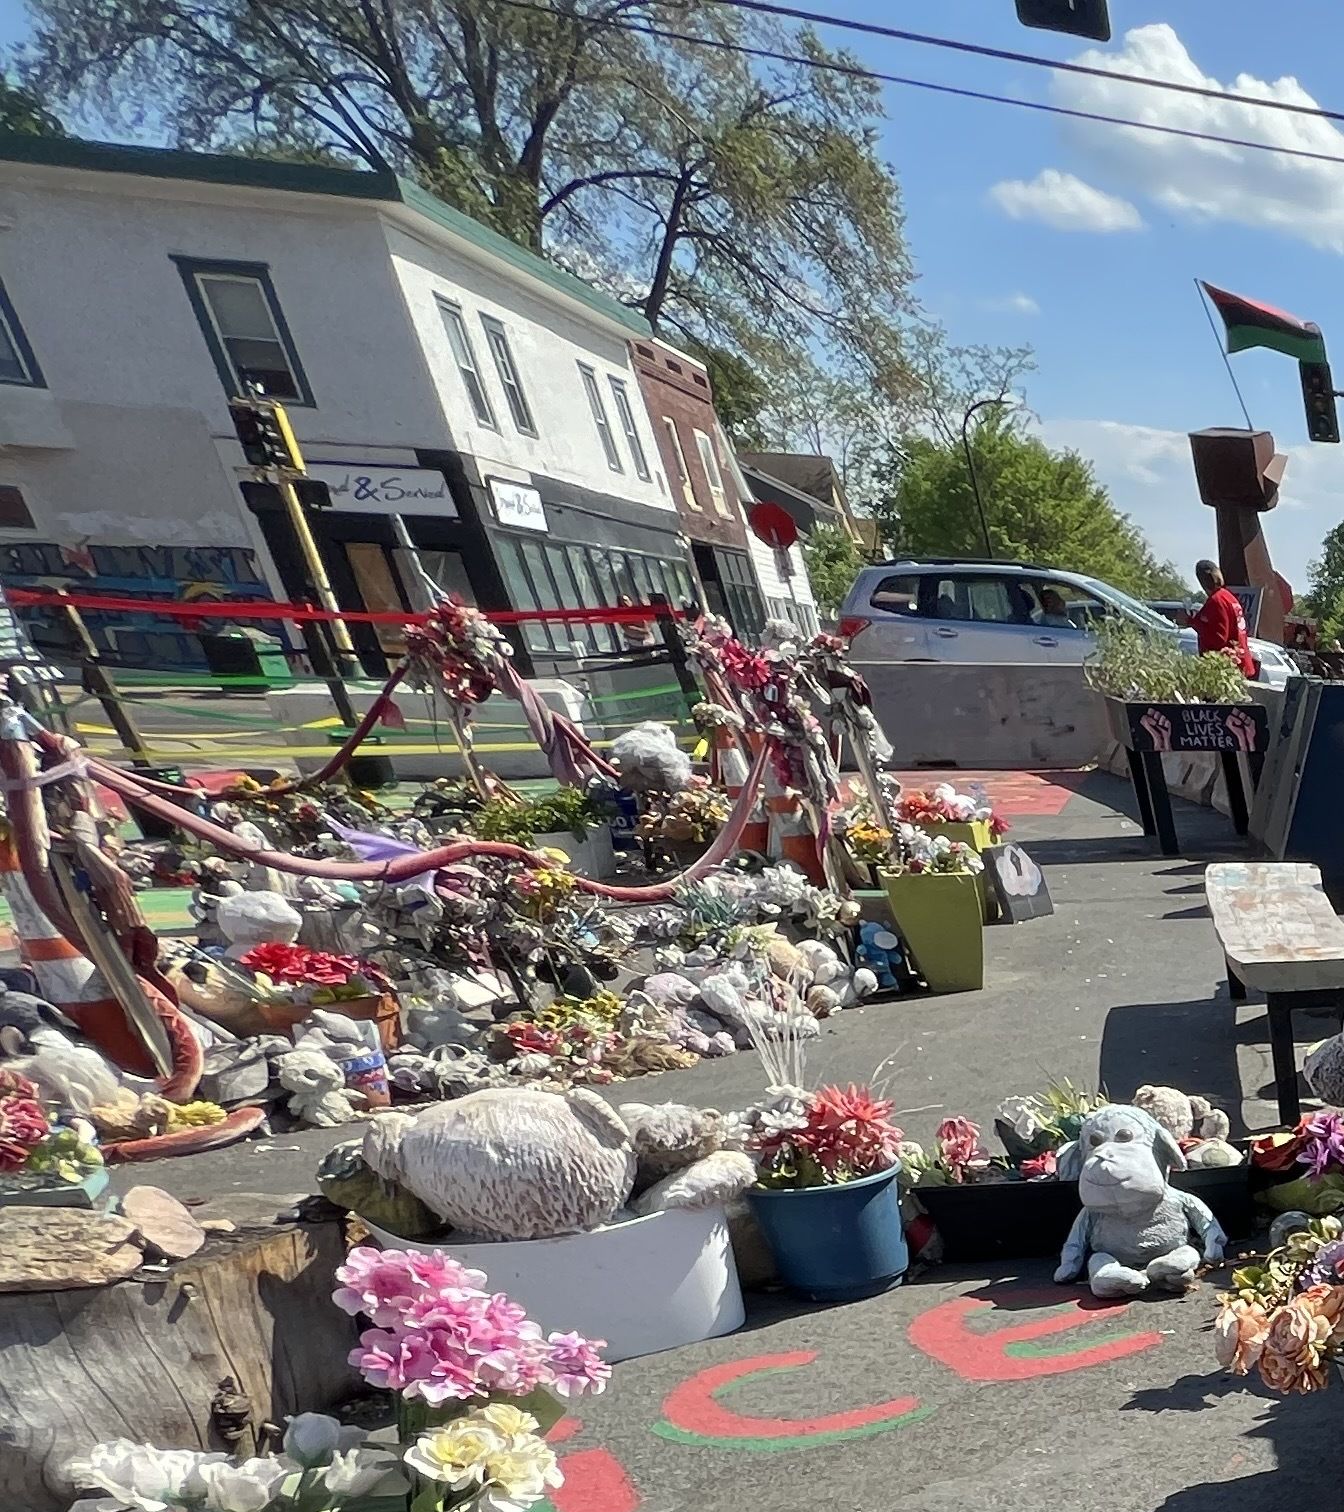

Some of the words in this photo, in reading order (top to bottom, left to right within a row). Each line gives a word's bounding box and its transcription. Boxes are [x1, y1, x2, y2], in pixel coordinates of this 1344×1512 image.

[353, 476, 381, 501] &
[1183, 710, 1220, 722] BLACK
[1187, 723, 1224, 734] LIVES
[1181, 736, 1234, 748] MATTER
